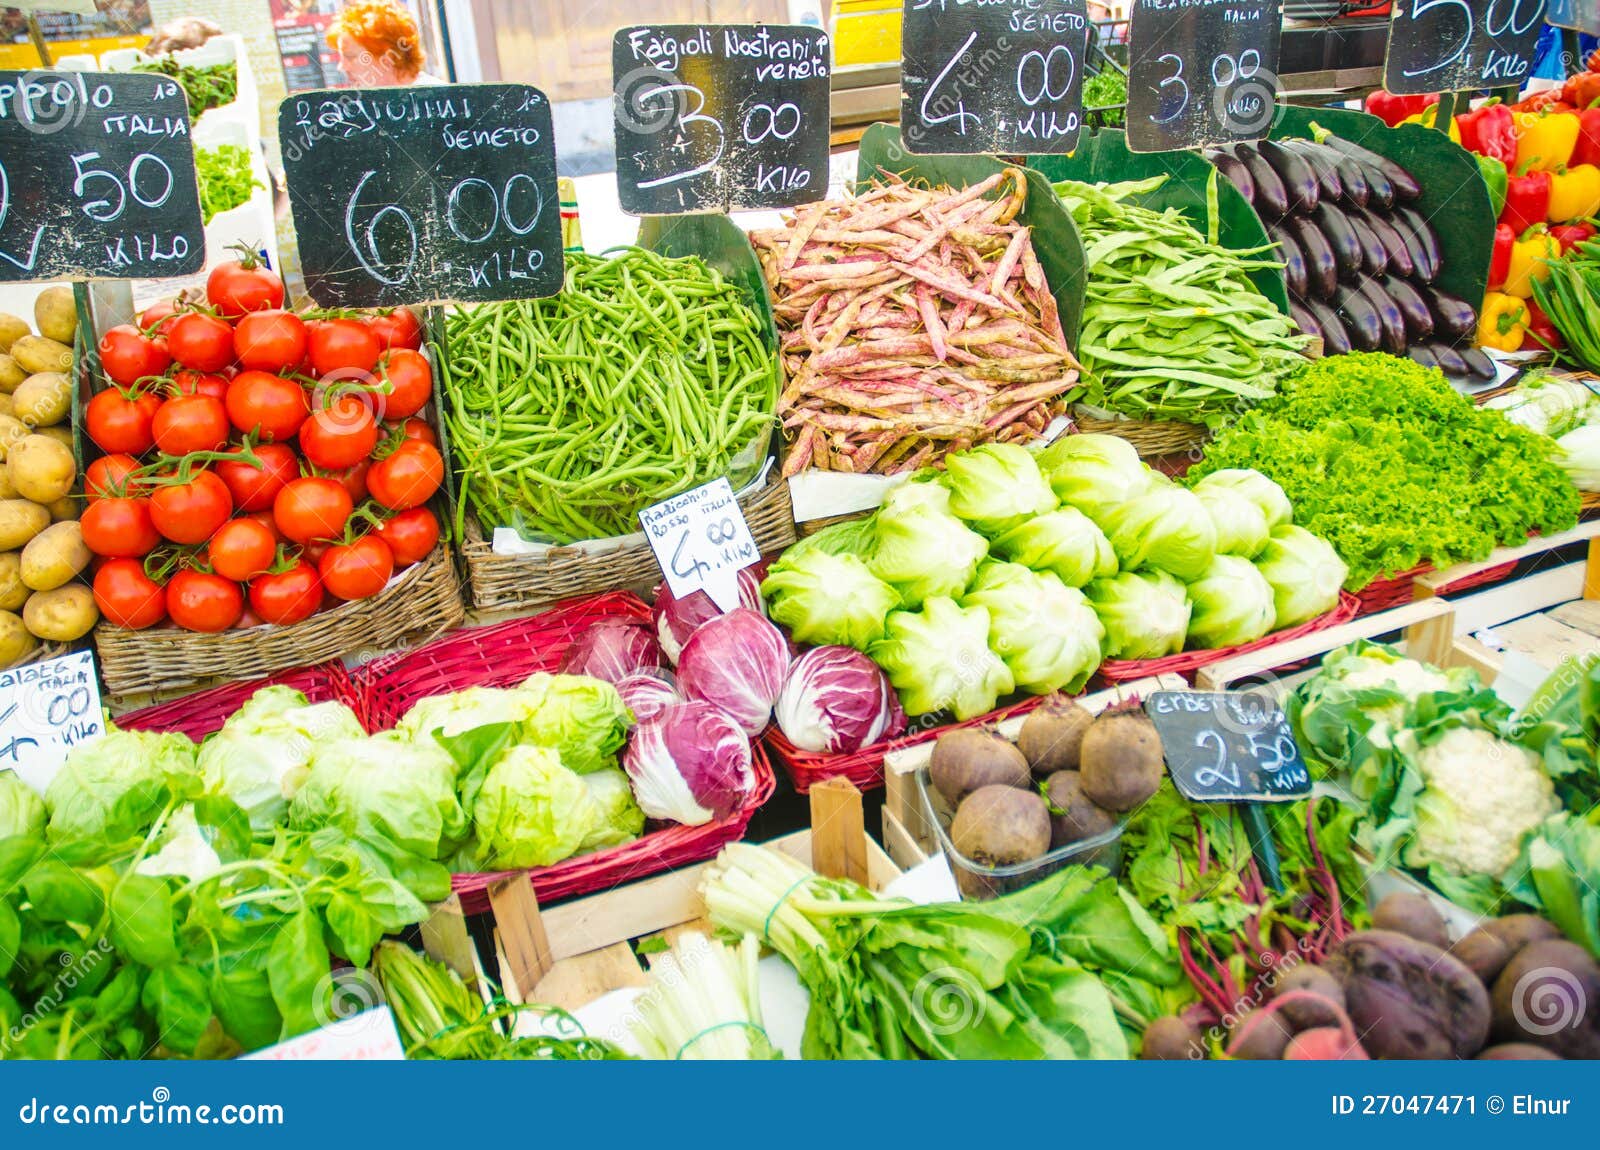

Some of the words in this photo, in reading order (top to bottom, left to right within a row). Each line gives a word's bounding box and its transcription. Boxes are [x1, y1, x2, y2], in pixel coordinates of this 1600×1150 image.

[628, 27, 713, 71] Fagioli
[724, 27, 810, 59] Nostrani
[104, 114, 187, 137] ITALIA
[105, 233, 189, 266] KILO
[469, 248, 544, 288] KILO
